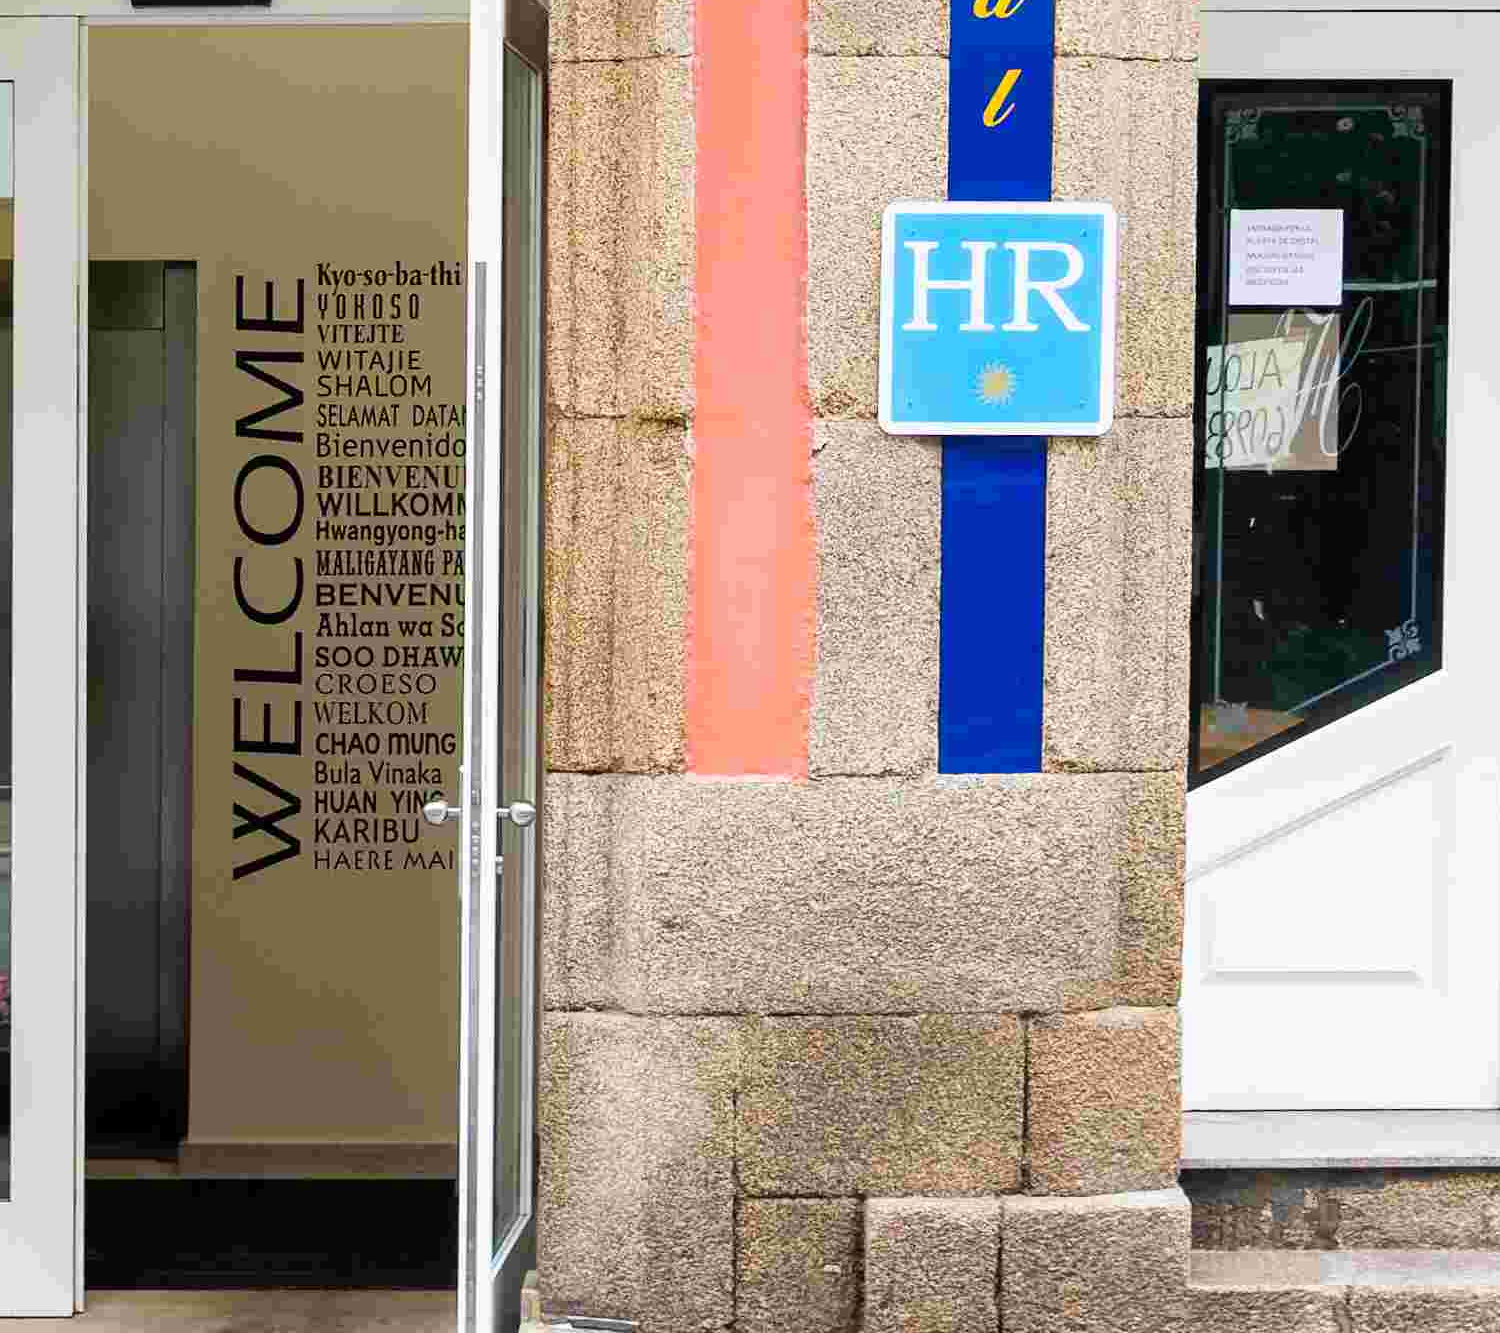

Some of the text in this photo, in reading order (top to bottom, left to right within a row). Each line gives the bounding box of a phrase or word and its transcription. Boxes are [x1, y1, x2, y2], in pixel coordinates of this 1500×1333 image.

[902, 240, 1091, 332] HR
[317, 324, 405, 343] VITEJTE
[317, 350, 422, 373] WITAJIE
[316, 375, 432, 397] SHALOM
[316, 404, 466, 427] SELAMAT DATA
[316, 550, 434, 576] MALIGAYANG
[232, 274, 305, 881] WELCOME
[317, 613, 390, 637] Ahlan
[398, 620, 433, 637] wa
[315, 646, 374, 668] SOO
[315, 674, 437, 694] CROESO
[314, 701, 428, 725] WELKOM
[315, 733, 380, 755] CHAO
[315, 761, 442, 784] Bula Vinaka
[315, 790, 377, 814] HUAN
[315, 818, 419, 844] KARIBU
[315, 850, 455, 870] HAERE MAI
